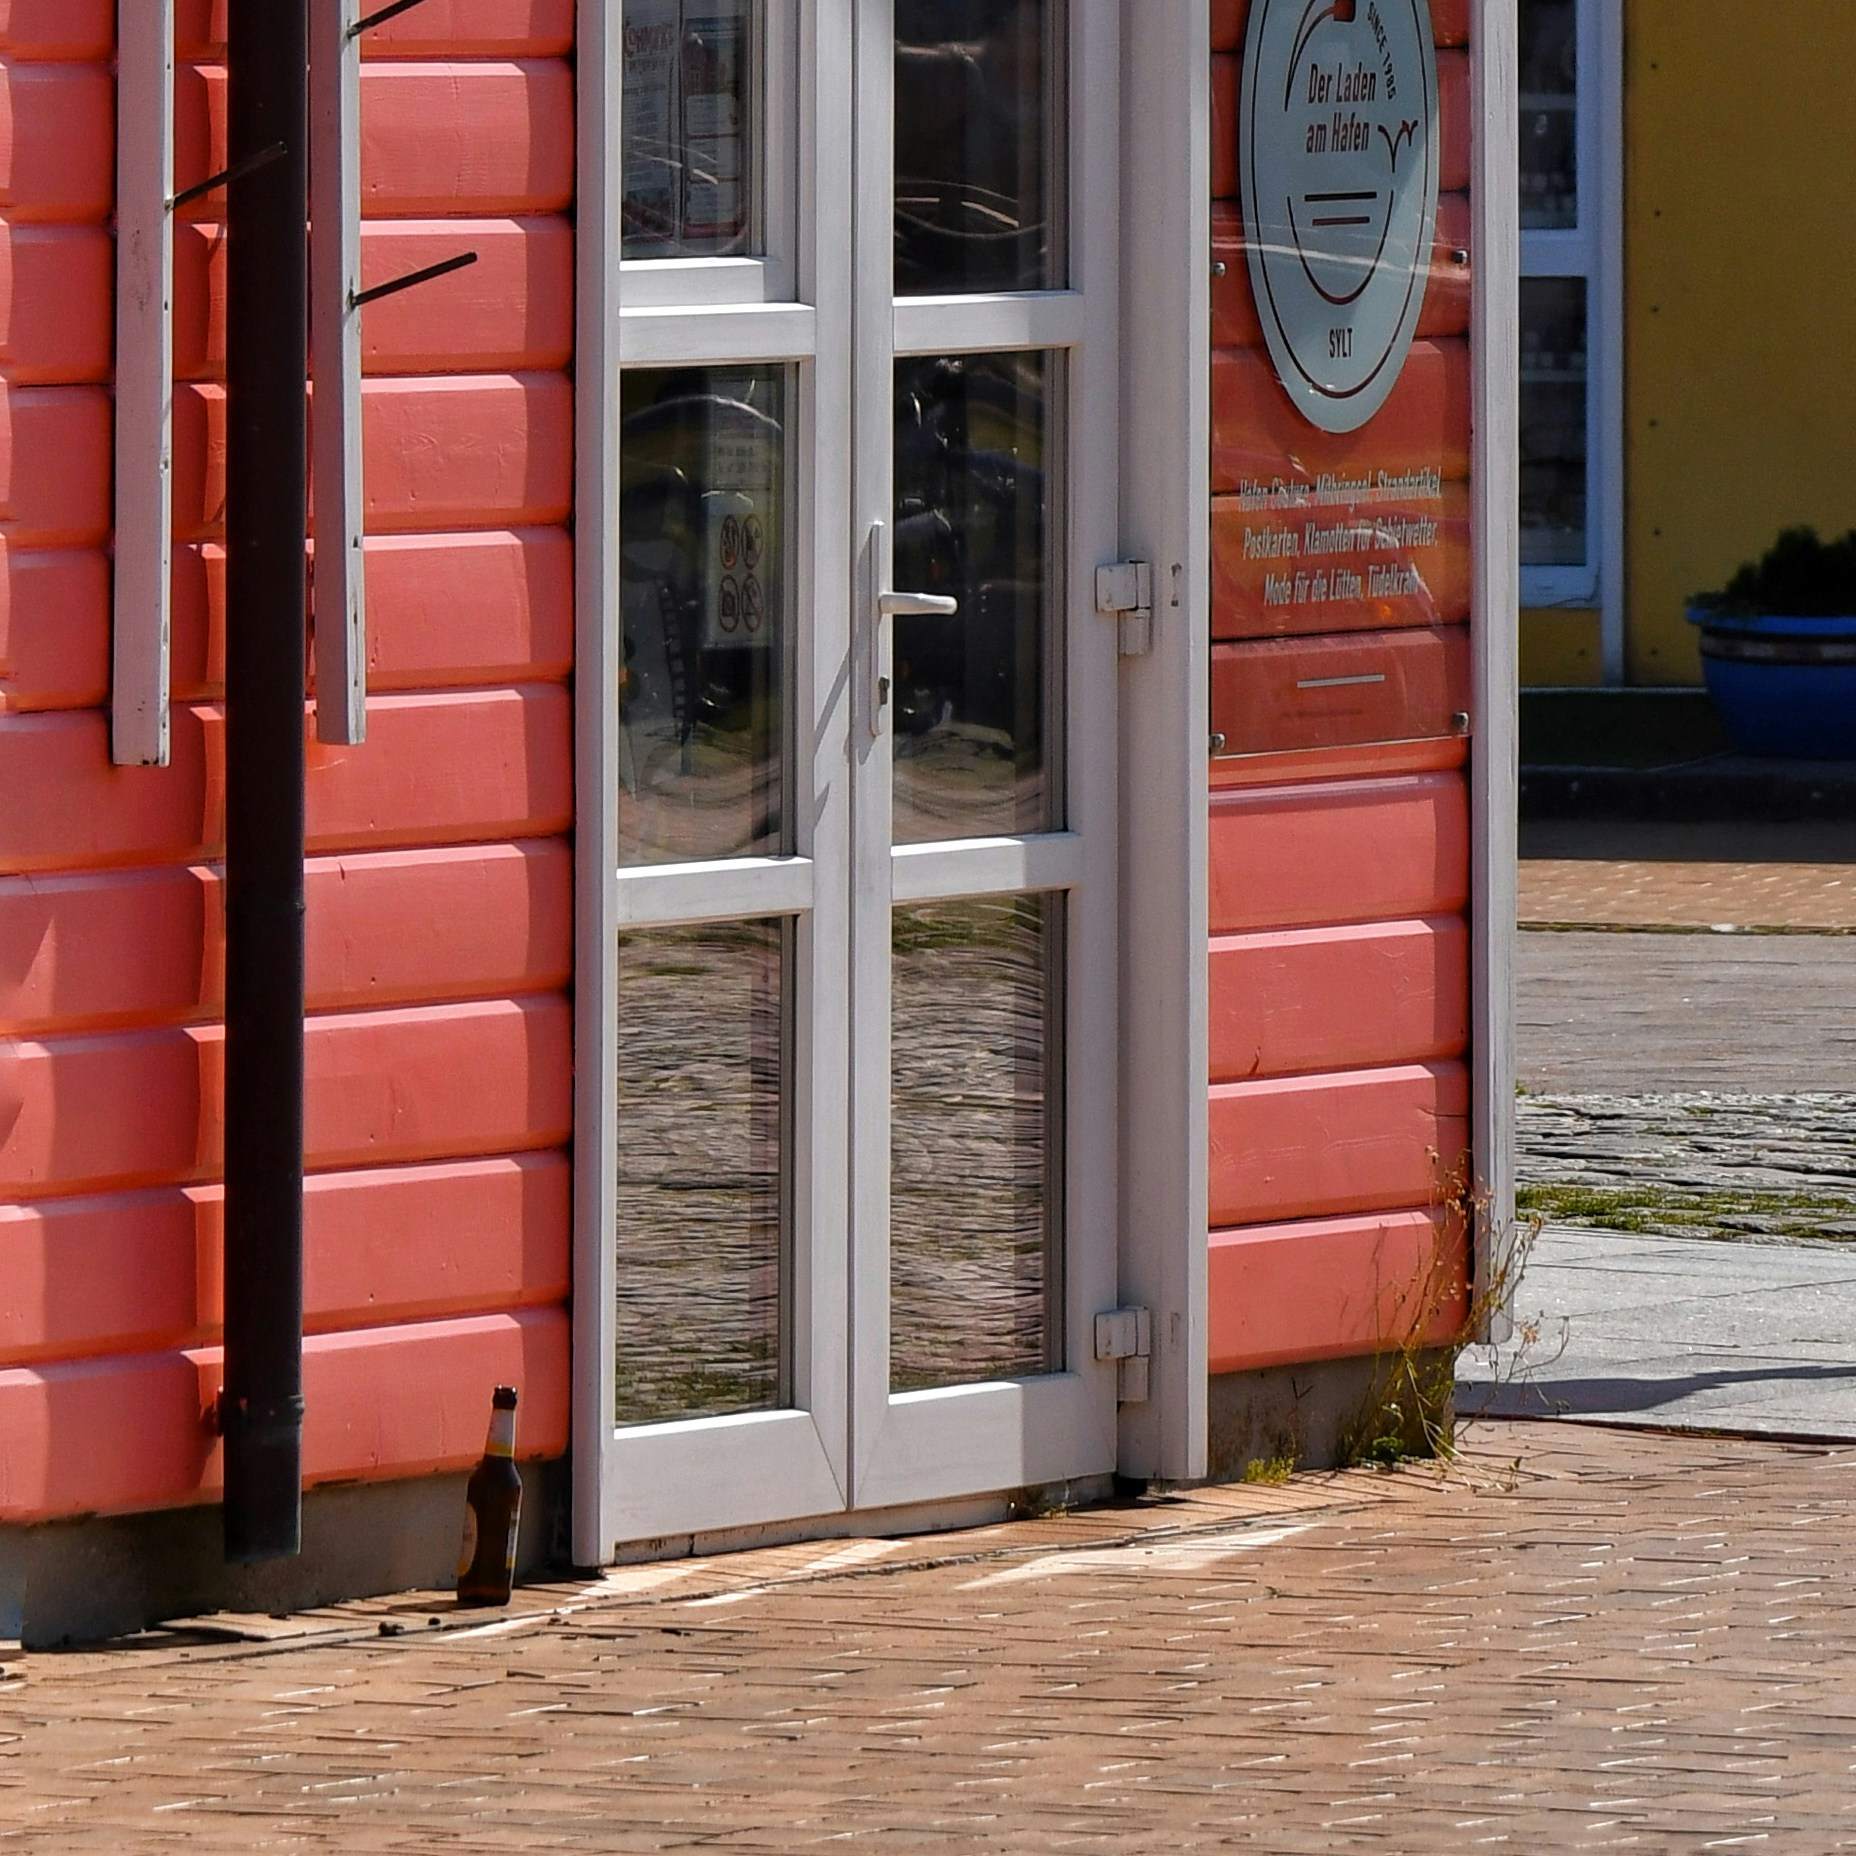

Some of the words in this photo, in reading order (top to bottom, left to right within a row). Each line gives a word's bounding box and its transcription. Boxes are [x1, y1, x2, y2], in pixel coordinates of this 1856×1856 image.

[1367, 1, 1388, 55] SINCE
[1382, 51, 1397, 101] 1985
[1308, 62, 1333, 105] Der
[1335, 60, 1377, 103] Laden
[1305, 122, 1327, 154] am
[1330, 110, 1370, 153] Hafen
[1329, 327, 1353, 359] SYLT
[1242, 525, 1300, 561] Postkarten,
[1303, 522, 1354, 556] Klamotten
[1263, 573, 1291, 607] Mode
[1293, 570, 1310, 605] für
[1311, 569, 1328, 603] die
[1329, 568, 1364, 601] Lütten,
